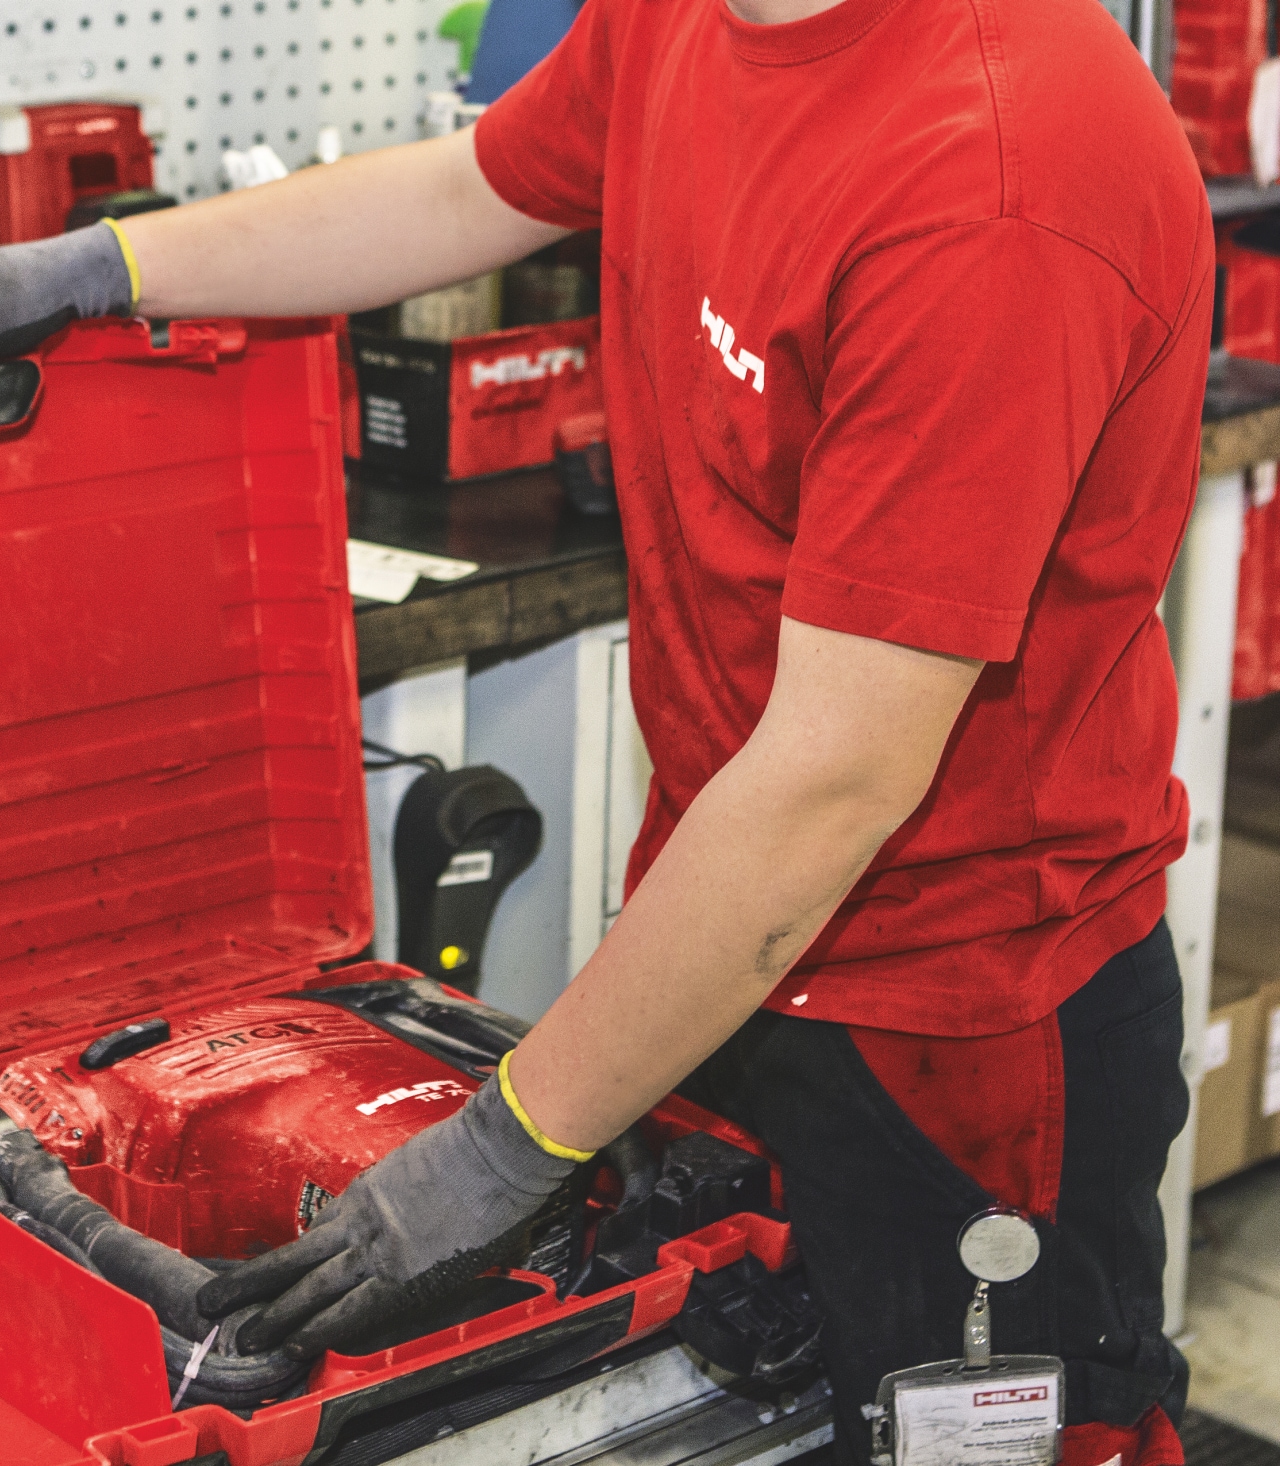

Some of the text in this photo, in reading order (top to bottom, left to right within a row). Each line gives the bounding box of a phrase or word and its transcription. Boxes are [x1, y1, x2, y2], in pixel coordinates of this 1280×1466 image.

[471, 347, 586, 388] HILTI
[356, 1080, 462, 1116] HILTI
[415, 1092, 445, 1102] TE
[976, 1388, 1046, 1406] HILTI
